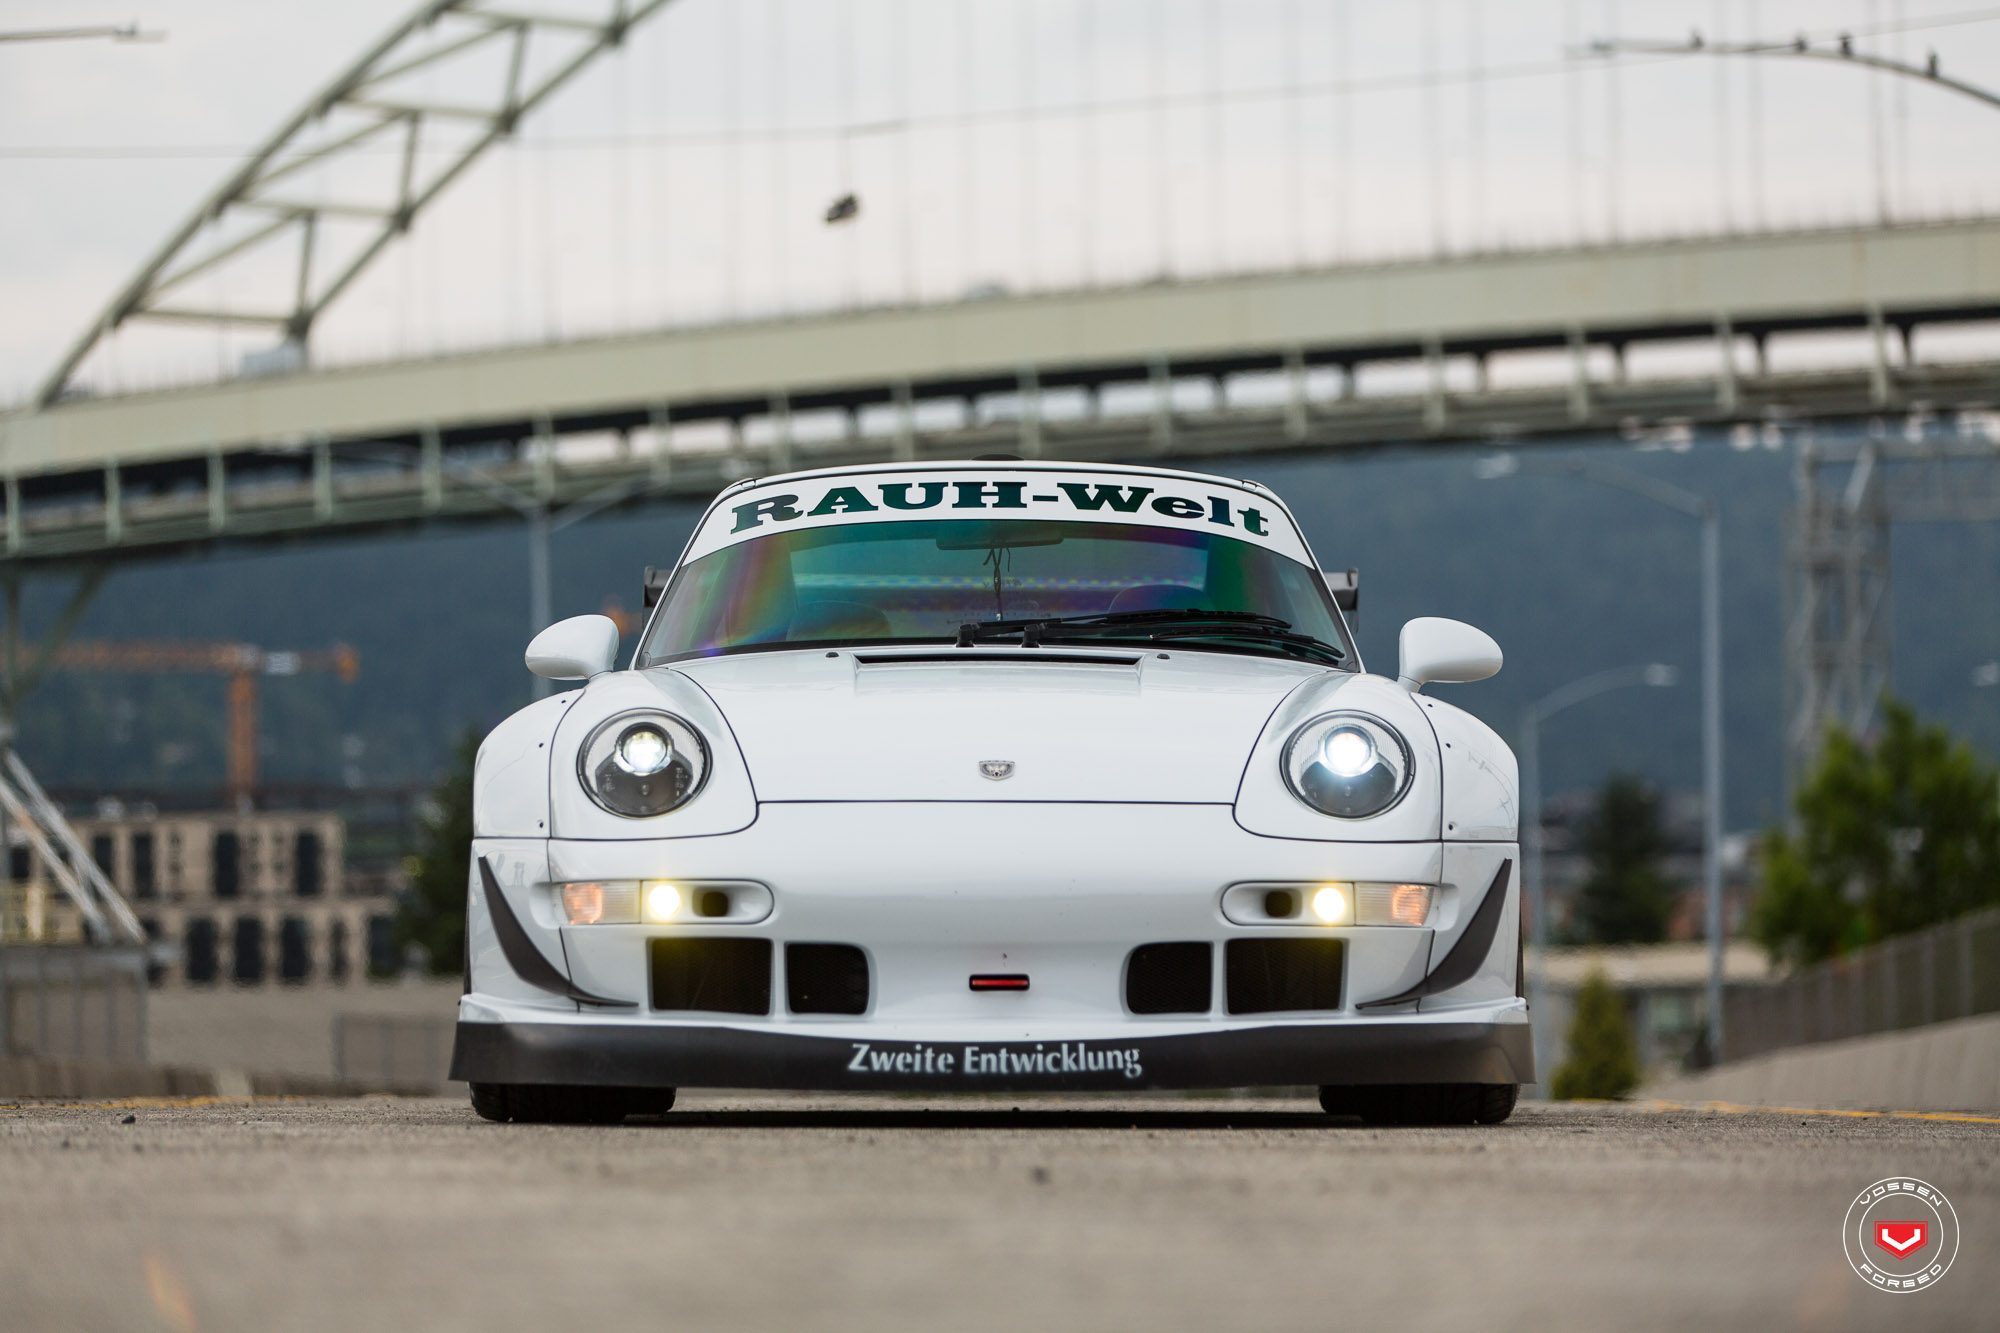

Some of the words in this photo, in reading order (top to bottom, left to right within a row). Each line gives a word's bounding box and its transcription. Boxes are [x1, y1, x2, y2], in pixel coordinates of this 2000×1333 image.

[731, 481, 1269, 536] RAUH-Welt
[849, 1043, 954, 1073] Zweite
[964, 1043, 1142, 1079] Entwicklung
